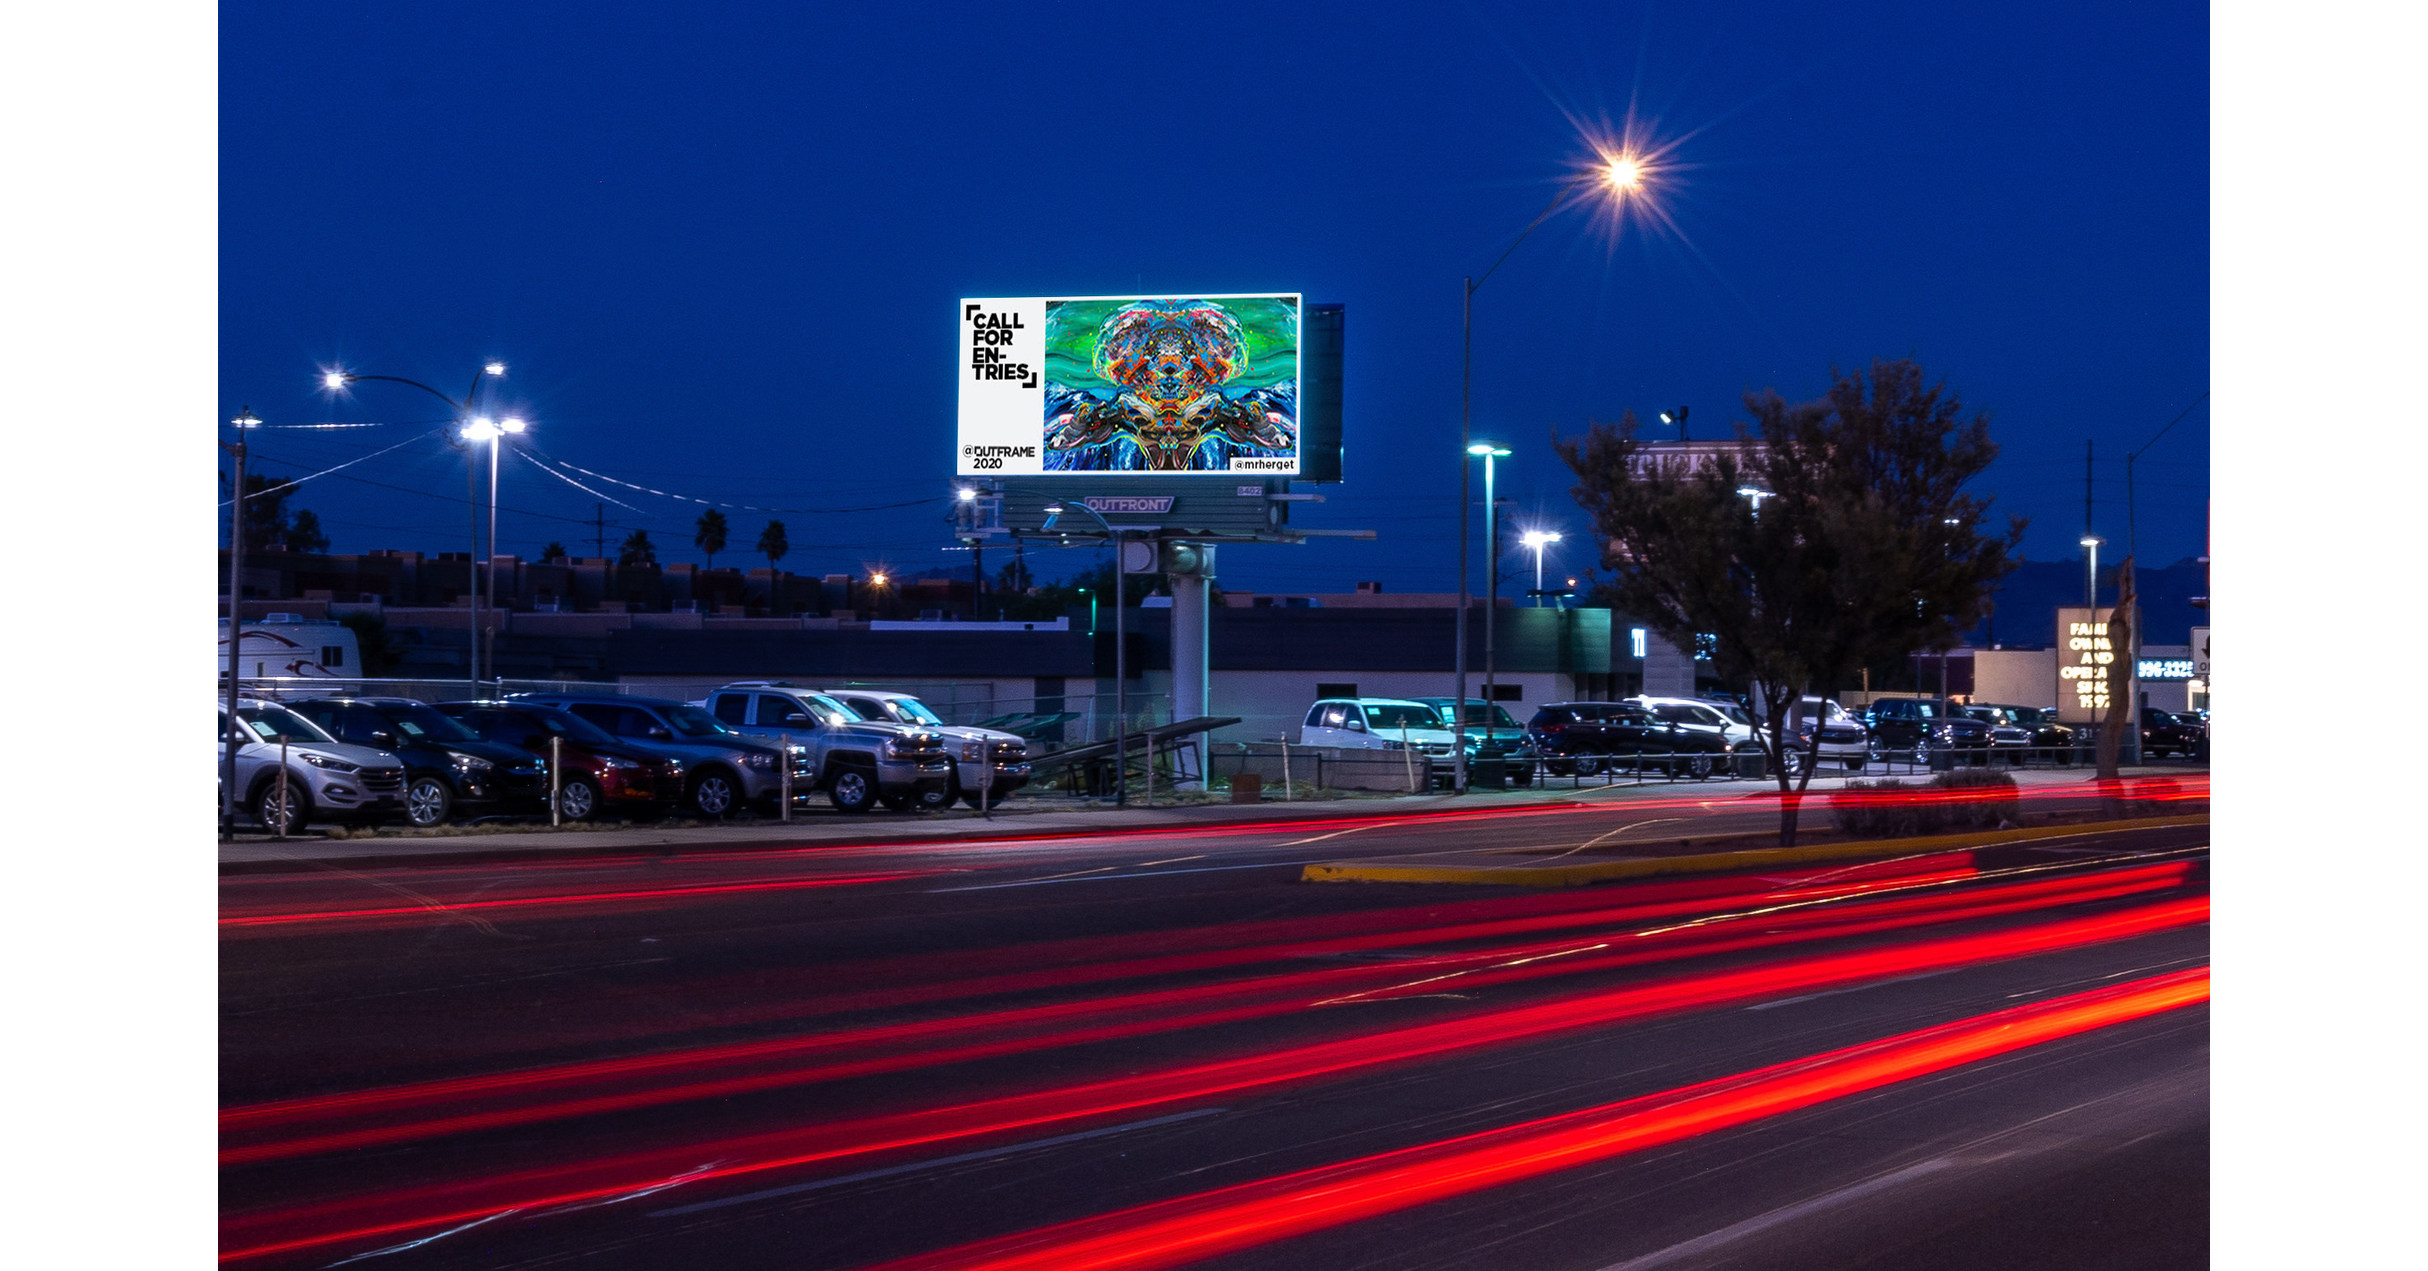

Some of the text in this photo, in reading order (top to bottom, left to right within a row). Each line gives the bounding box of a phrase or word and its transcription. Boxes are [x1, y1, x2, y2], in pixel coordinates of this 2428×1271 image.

[973, 312, 1024, 329] CALL
[973, 329, 1013, 346] FOR
[972, 347, 1006, 364] EN-
[971, 363, 1029, 380] TRIES
[963, 445, 1035, 458] @OUTFRAME
[973, 457, 1002, 469] 2020
[1235, 459, 1294, 471] @mrherget
[1238, 487, 1262, 496] 8402
[1088, 499, 1169, 511] OUTFRONT
[2070, 622, 2108, 636] FAMI
[2080, 651, 2115, 665] AND
[2060, 666, 2108, 680] OPERA
